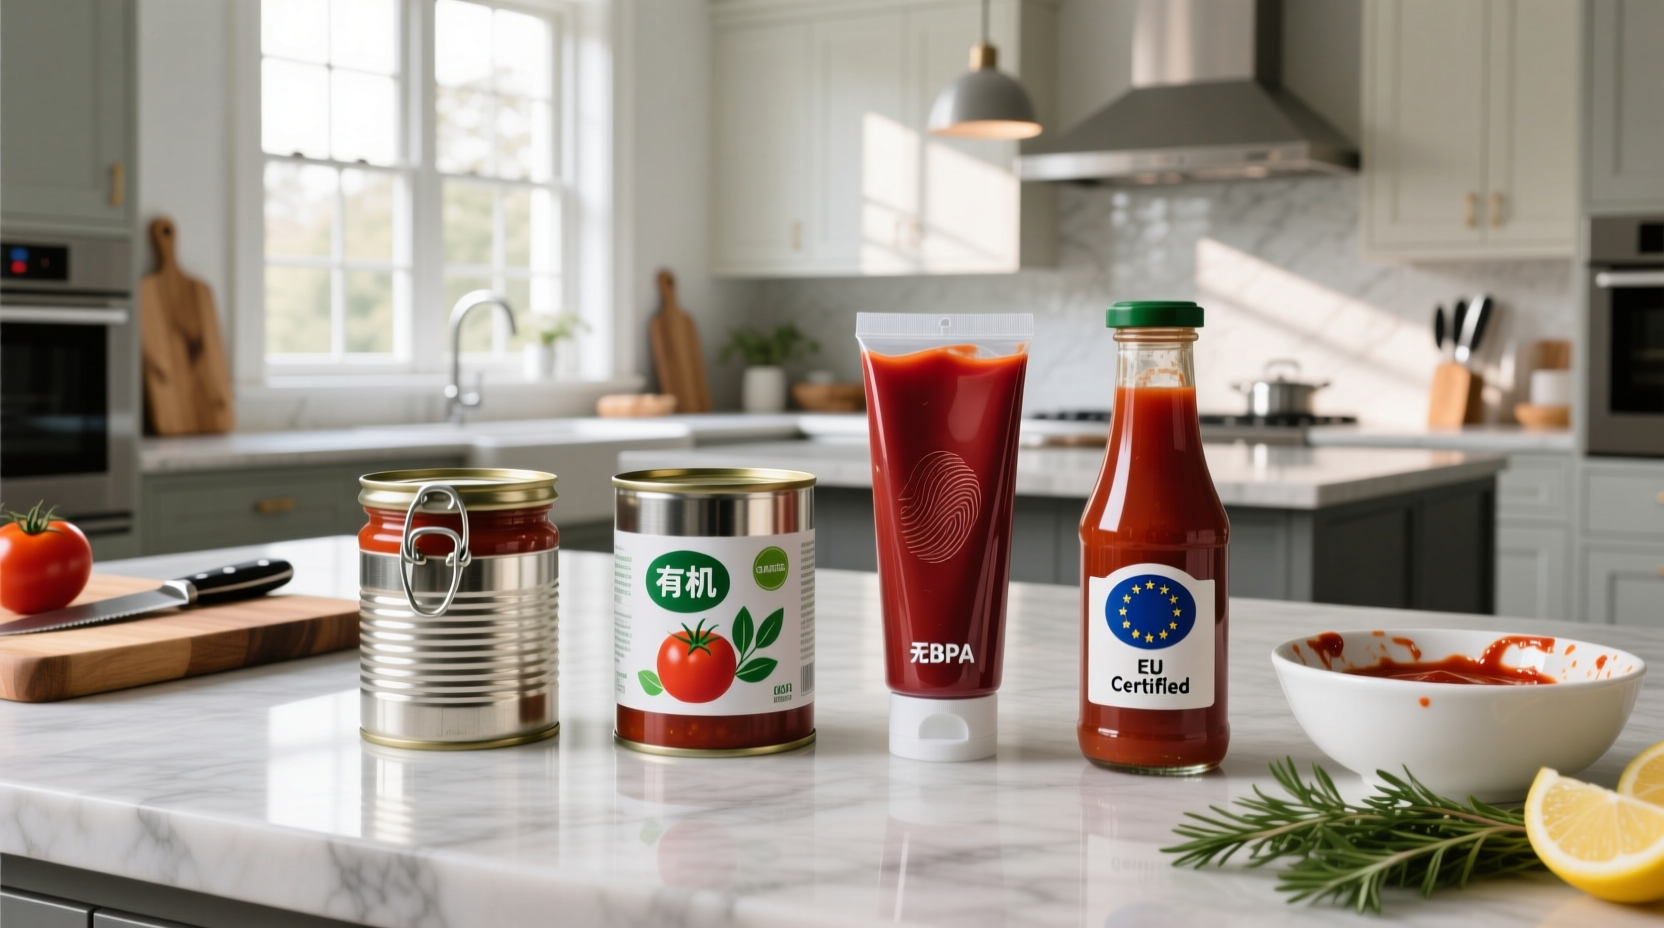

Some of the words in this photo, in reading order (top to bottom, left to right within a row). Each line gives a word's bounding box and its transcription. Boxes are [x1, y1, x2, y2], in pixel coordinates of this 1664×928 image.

[656, 565, 717, 598] 有机
[910, 642, 975, 664] 无BPA
[1138, 659, 1163, 675] EU
[1111, 676, 1190, 694] Certified
